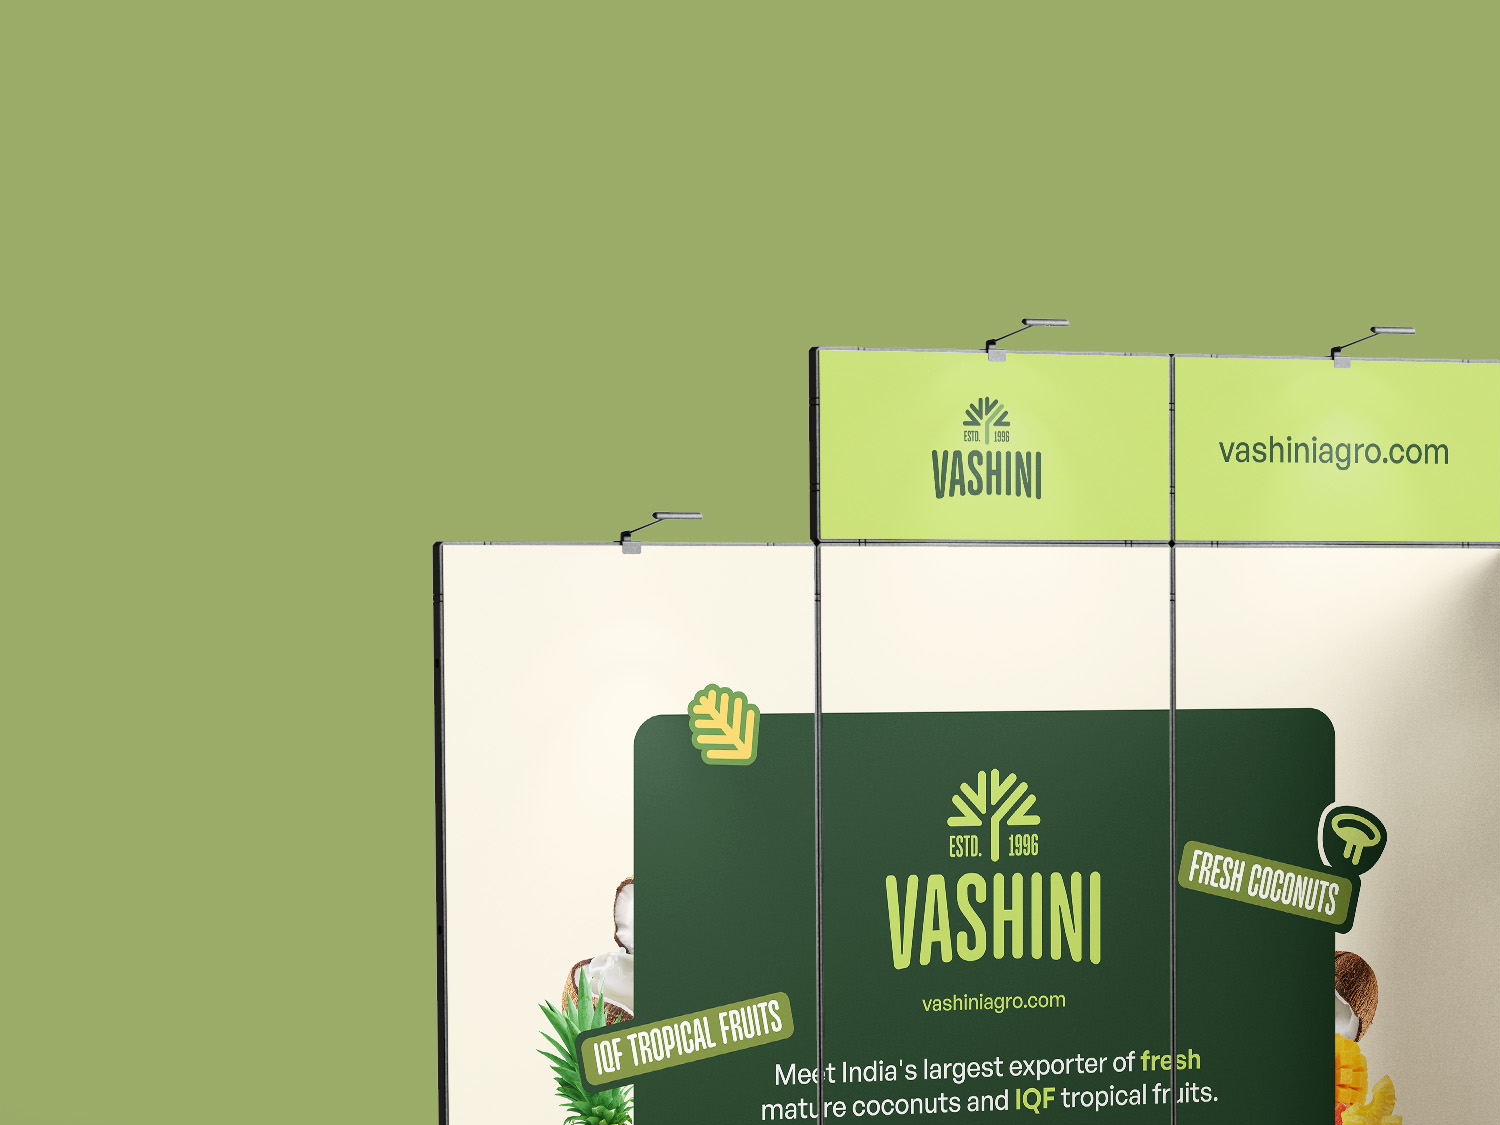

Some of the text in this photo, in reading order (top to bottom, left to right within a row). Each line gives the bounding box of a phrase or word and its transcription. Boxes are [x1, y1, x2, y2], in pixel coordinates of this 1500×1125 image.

[964, 430, 1010, 443] ESTD. 1996
[1219, 435, 1449, 470] vashiniagro.com
[932, 450, 1042, 499] VASHINI
[949, 833, 1039, 858] ESTD. 1996
[1189, 849, 1340, 916] FRESH COCONUTS
[886, 871, 1101, 970] VASHINI
[922, 994, 1066, 1014] vashiniagro.com
[593, 999, 783, 1075] IQF TROPICAL FRUITS
[775, 1048, 1201, 1086] Meet India's largest exporter of fresh
[761, 1098, 847, 1121] mature
[852, 1092, 961, 1118] coconuts
[967, 1088, 1009, 1113] and
[1016, 1086, 1056, 1114] IQF
[1061, 1083, 1147, 1112] tropical
